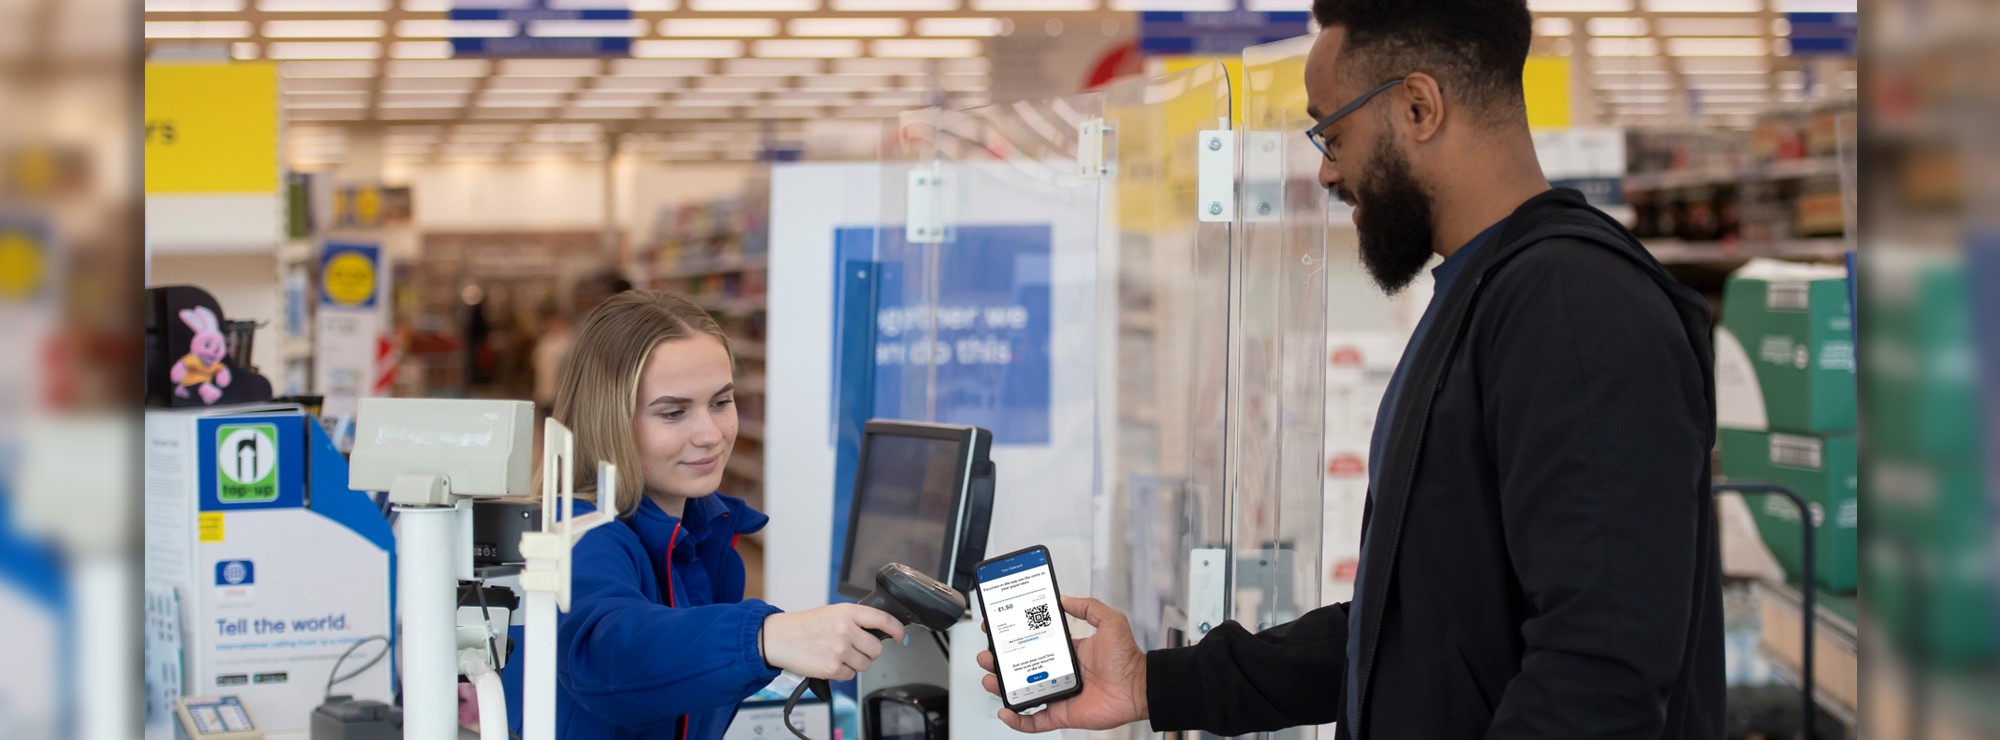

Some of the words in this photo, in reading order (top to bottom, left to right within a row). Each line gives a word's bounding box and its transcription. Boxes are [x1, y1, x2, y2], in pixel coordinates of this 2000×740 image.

[984, 305, 1028, 330] we
[911, 338, 952, 366] do
[223, 484, 273, 499] top-up
[998, 604, 1014, 612] £1.50
[216, 617, 248, 636] Tell
[254, 617, 286, 635] the
